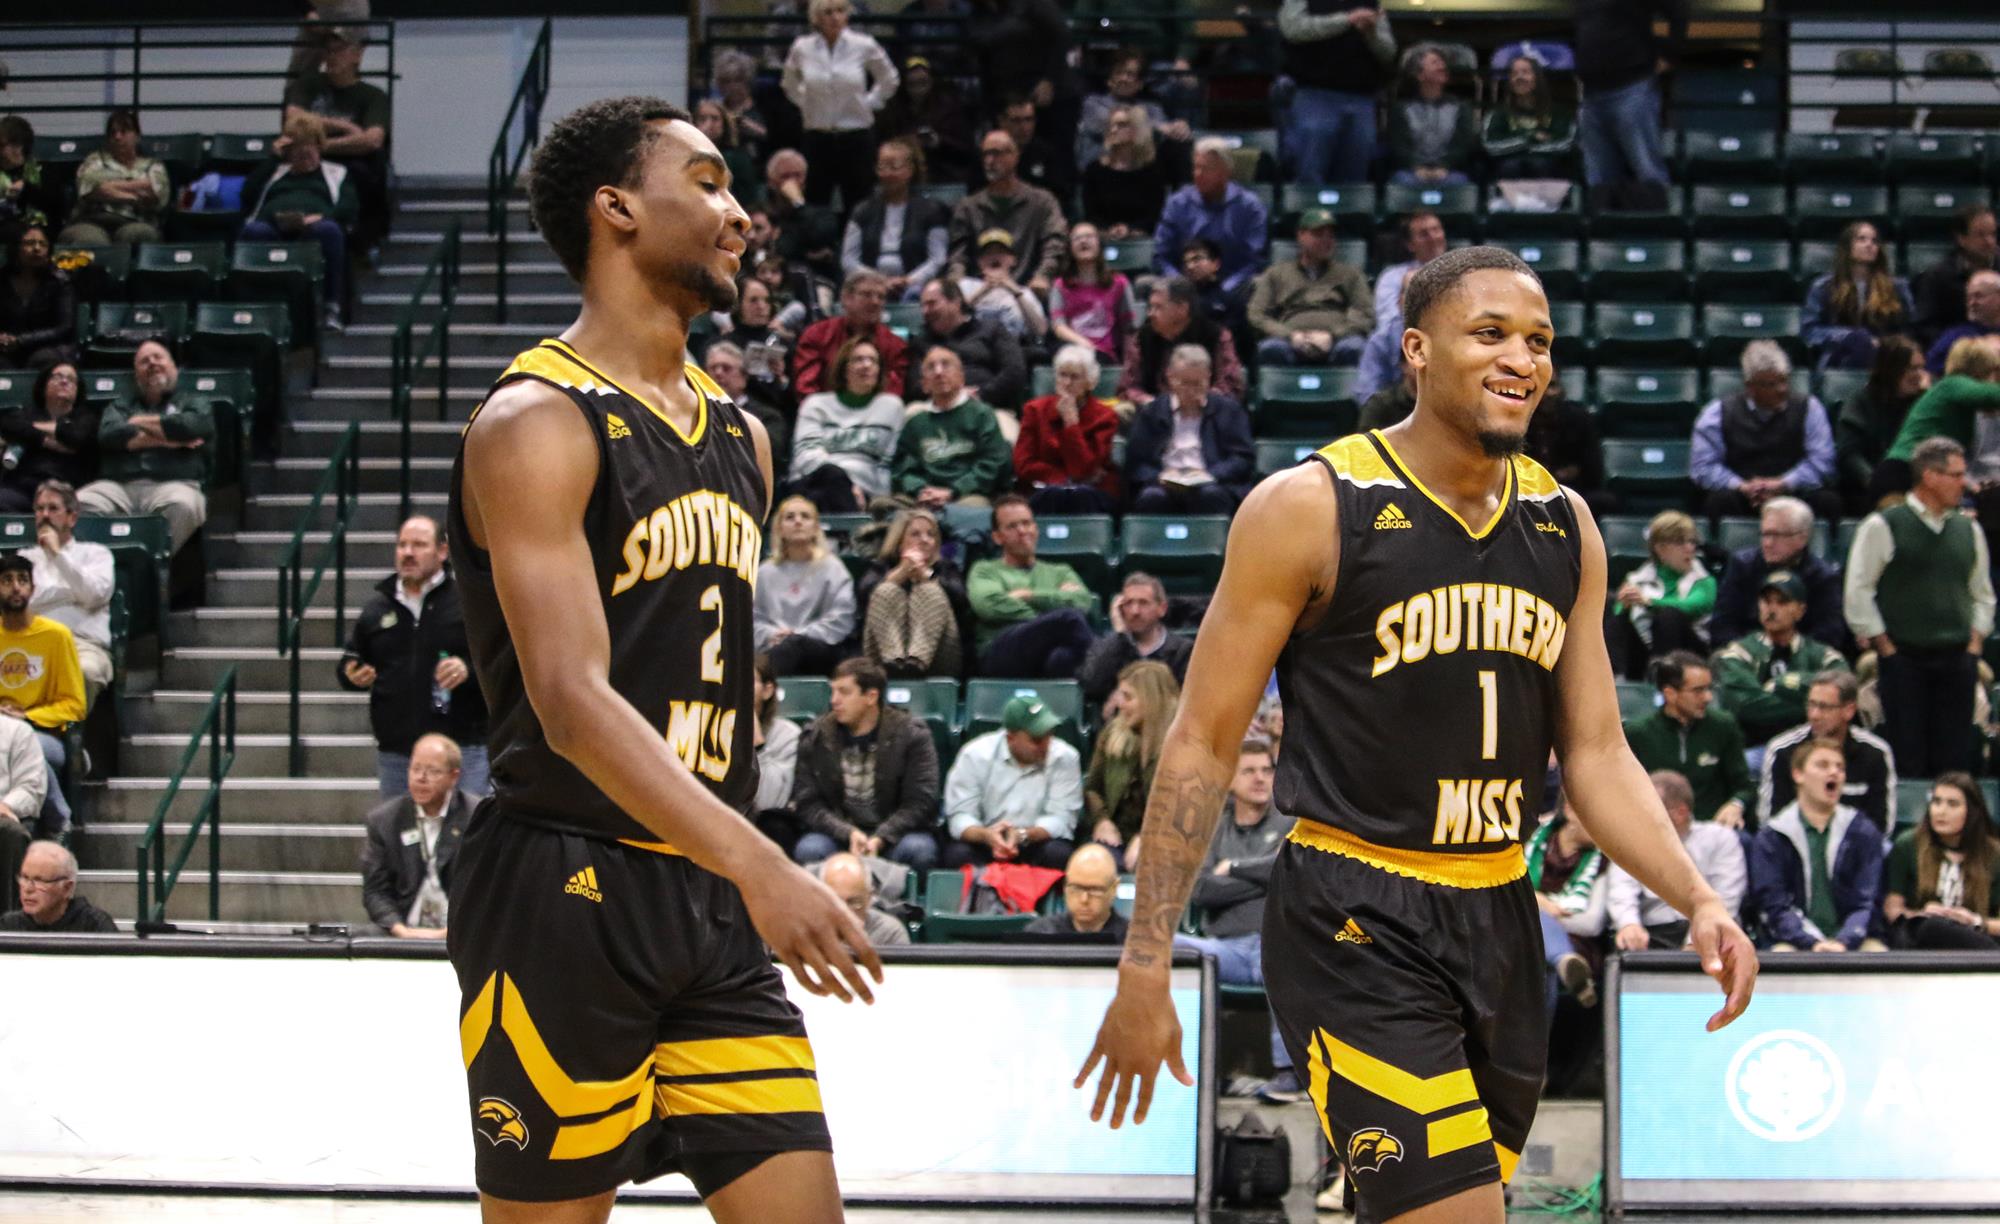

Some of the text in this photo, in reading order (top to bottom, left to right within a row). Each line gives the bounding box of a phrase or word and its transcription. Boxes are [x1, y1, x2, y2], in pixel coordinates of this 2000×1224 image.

[1374, 518, 1412, 530] adidas
[700, 584, 724, 685] 2
[1371, 582, 1567, 679] SOUTHERN
[1478, 670, 1498, 760] 1
[1432, 778, 1524, 845] MISS
[564, 882, 603, 903] adidas
